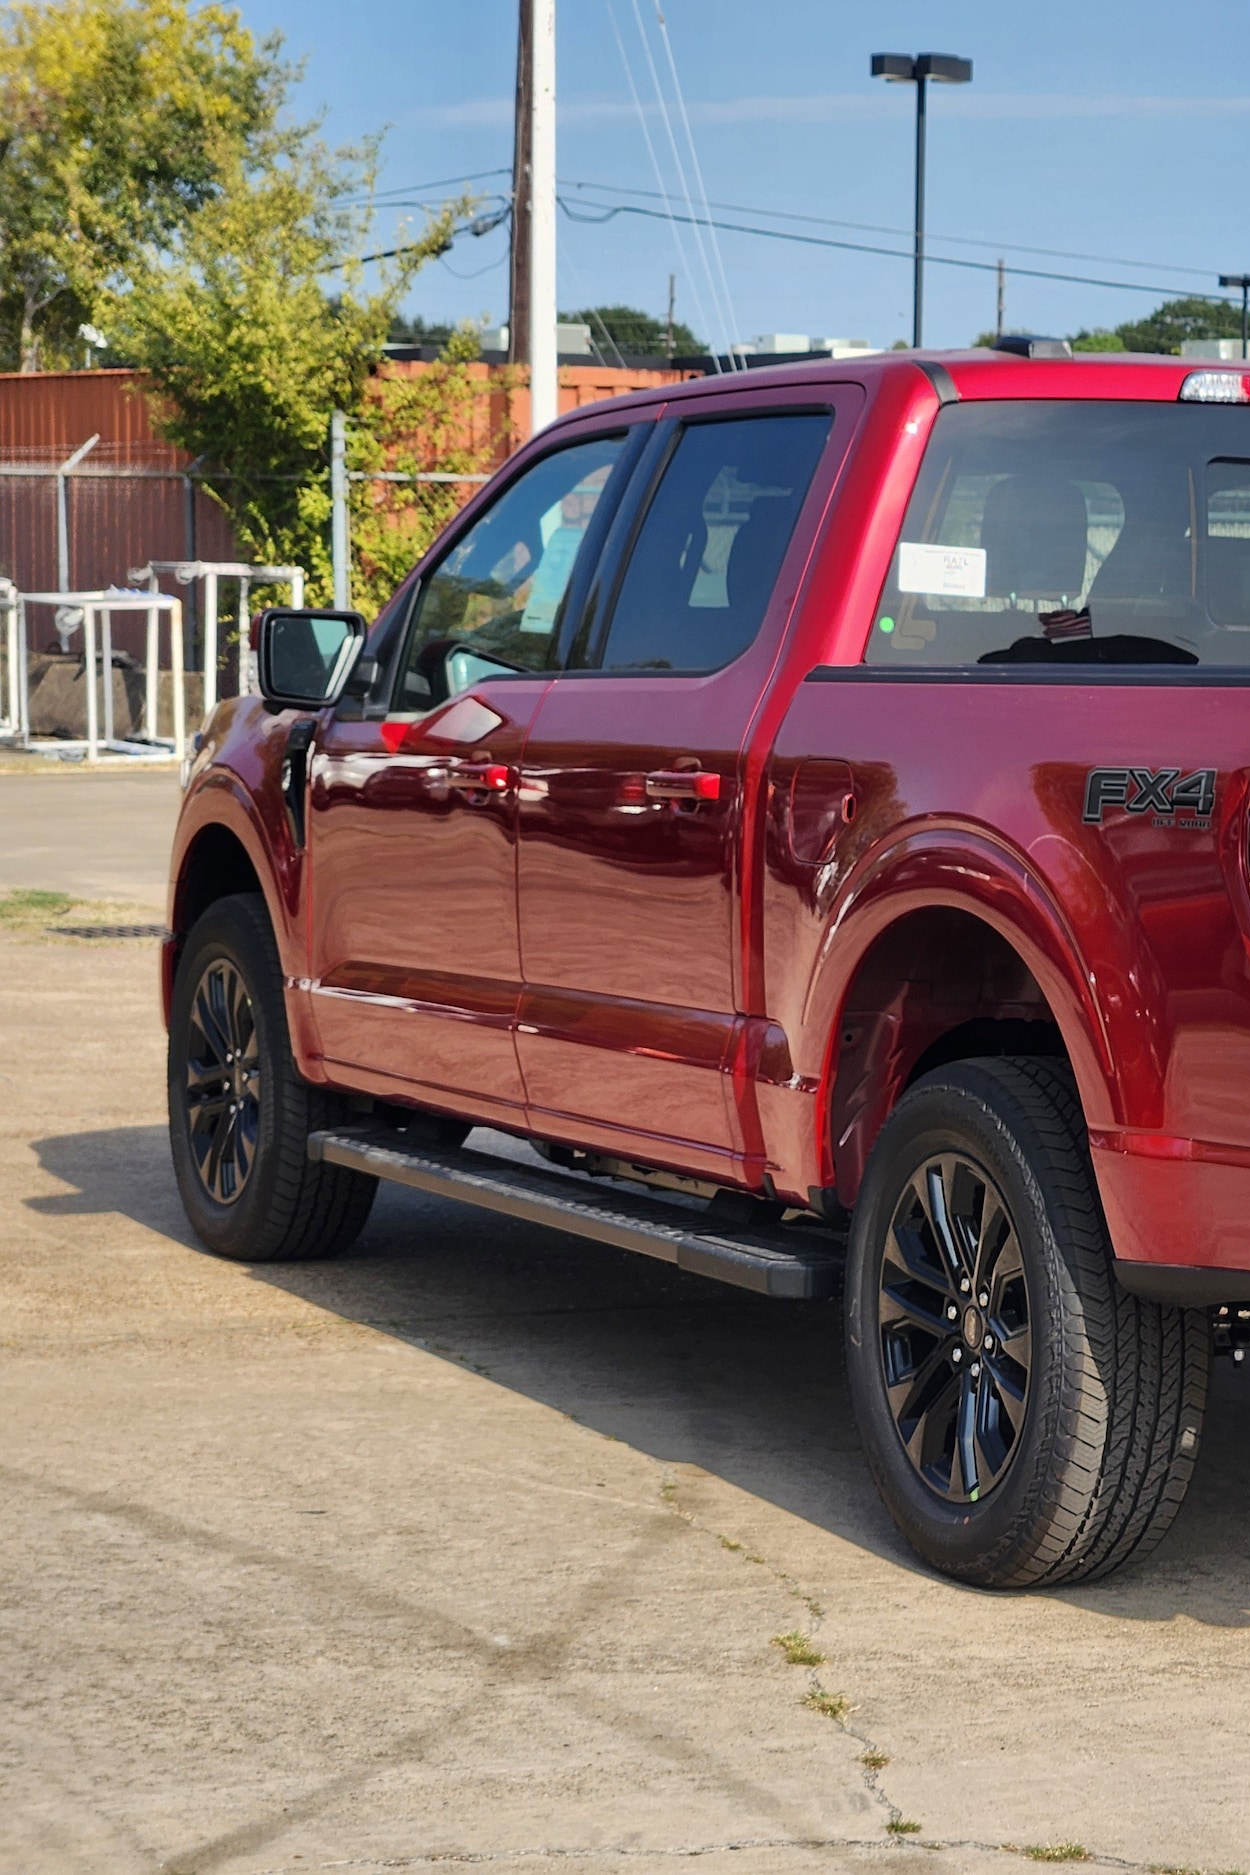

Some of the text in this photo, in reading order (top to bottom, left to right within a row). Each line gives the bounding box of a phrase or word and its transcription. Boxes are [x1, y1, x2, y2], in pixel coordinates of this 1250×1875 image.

[1082, 766, 1217, 824] FX4
[1152, 817, 1211, 829] OFF ROAD
